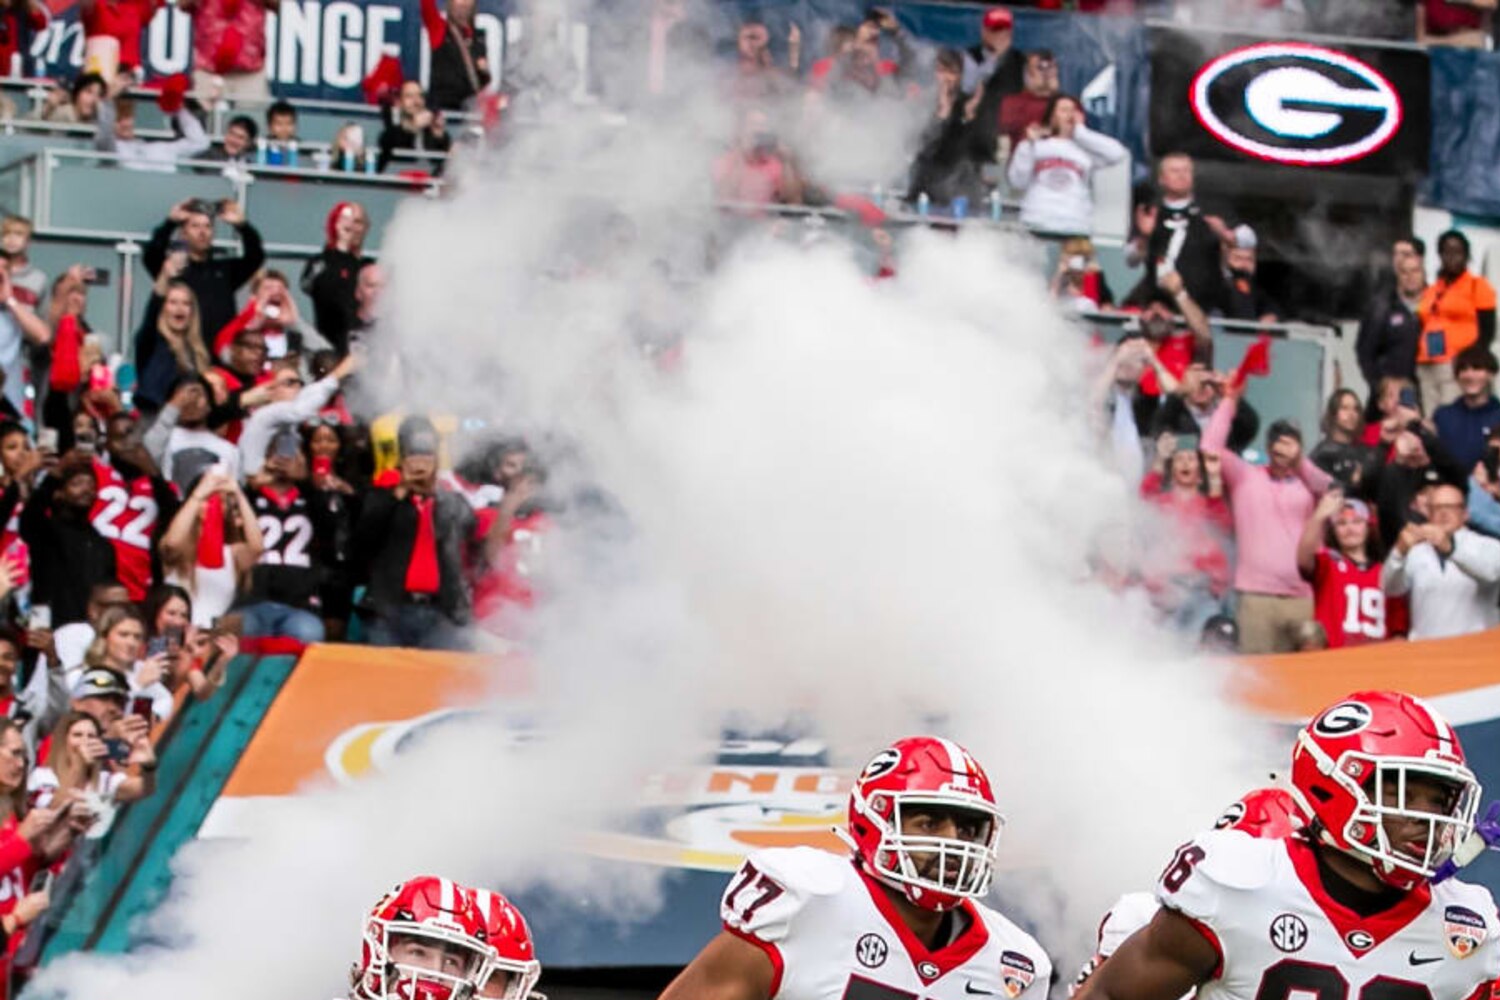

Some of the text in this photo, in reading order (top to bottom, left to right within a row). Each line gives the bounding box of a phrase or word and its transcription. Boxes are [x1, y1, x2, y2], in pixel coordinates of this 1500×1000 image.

[93, 484, 158, 548] 22
[259, 514, 314, 567] 22
[1343, 584, 1387, 638] 19
[726, 860, 785, 924] 77
[858, 934, 887, 966] SEC
[1271, 915, 1307, 951] SEC
